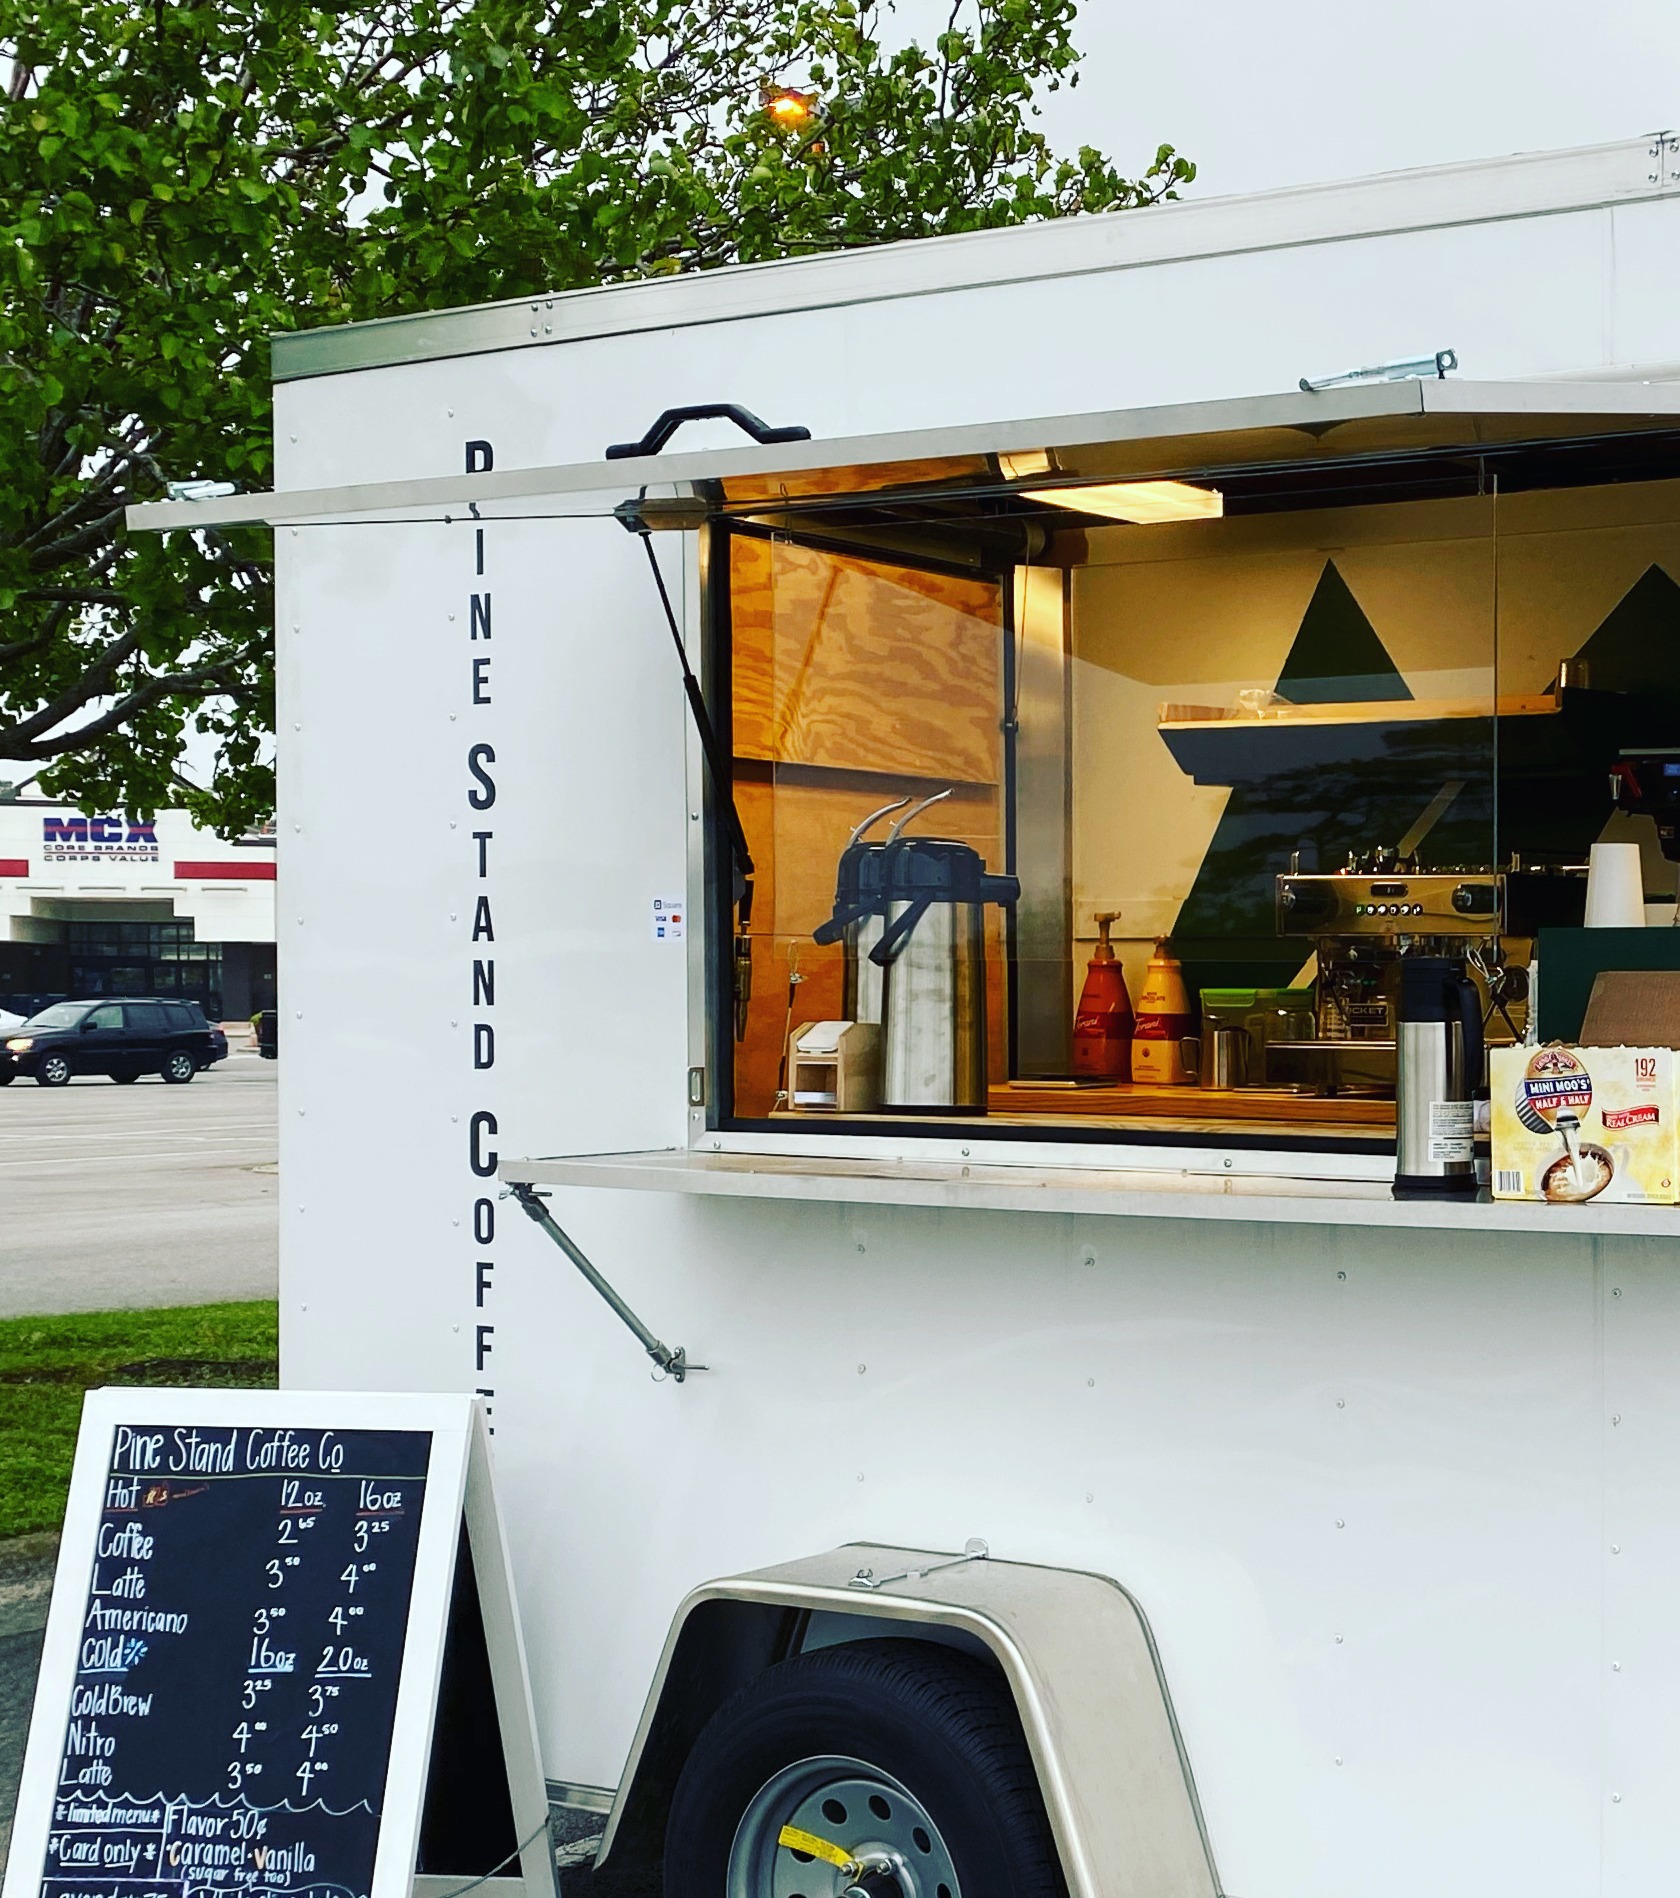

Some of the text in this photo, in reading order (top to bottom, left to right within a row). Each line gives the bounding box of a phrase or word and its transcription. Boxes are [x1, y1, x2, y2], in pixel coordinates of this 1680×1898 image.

[43, 817, 158, 842] MCX
[468, 743, 496, 1069] STAND
[1634, 1058, 1656, 1076] 192
[1530, 1081, 1554, 1093] MINI
[1535, 1097, 1558, 1109] HALF
[1568, 1095, 1590, 1104] HALF
[1626, 1112, 1656, 1124] CREAM
[113, 1427, 344, 1473] Pine Stand Coffee Co
[106, 1479, 141, 1509] Hot
[99, 1522, 153, 1560] Coffee
[91, 1563, 146, 1599] Latte
[85, 1599, 188, 1634] Americano
[67, 1721, 116, 1757] Nitro
[60, 1759, 113, 1786] Latte
[167, 1804, 229, 1838] Flavor
[60, 1834, 141, 1873] Card only
[233, 1867, 259, 1883] free
